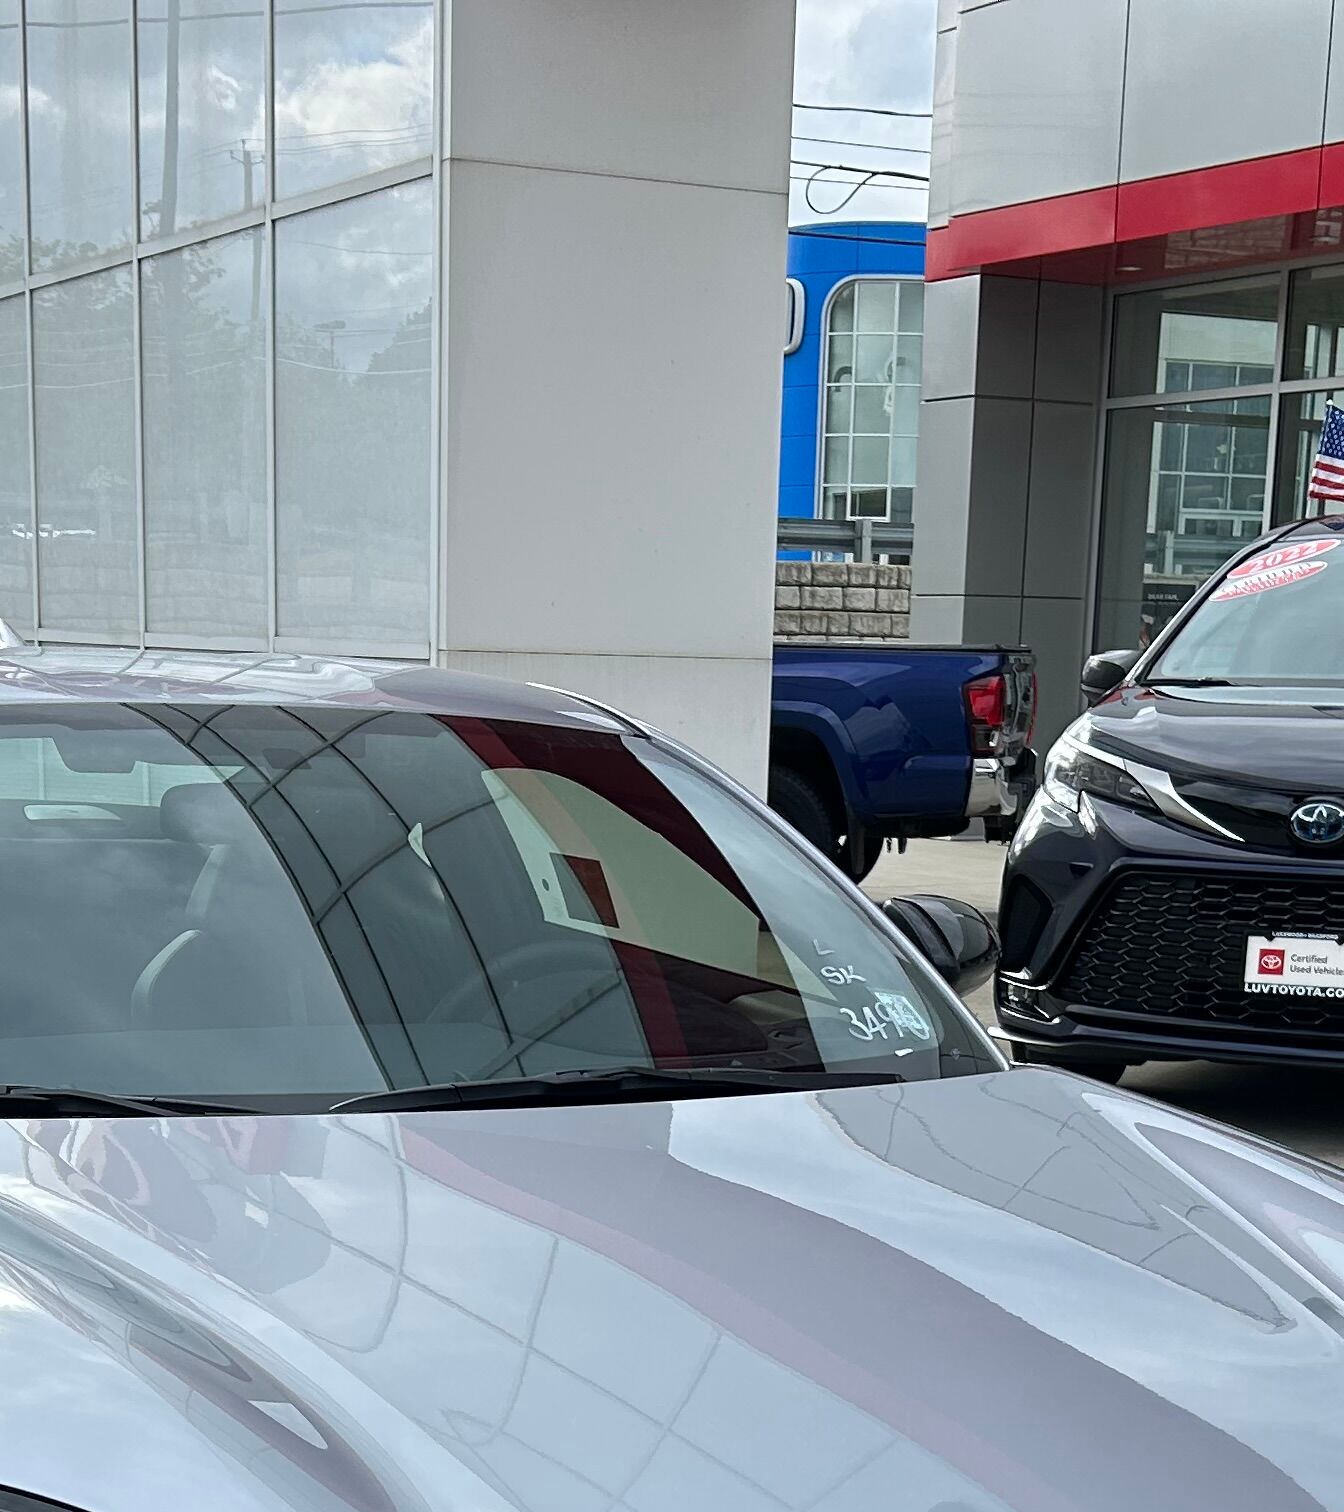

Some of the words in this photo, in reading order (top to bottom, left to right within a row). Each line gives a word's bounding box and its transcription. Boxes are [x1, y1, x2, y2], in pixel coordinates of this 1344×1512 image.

[1290, 953, 1328, 964] Certified
[820, 965, 867, 985] SK
[1290, 965, 1312, 974] Used
